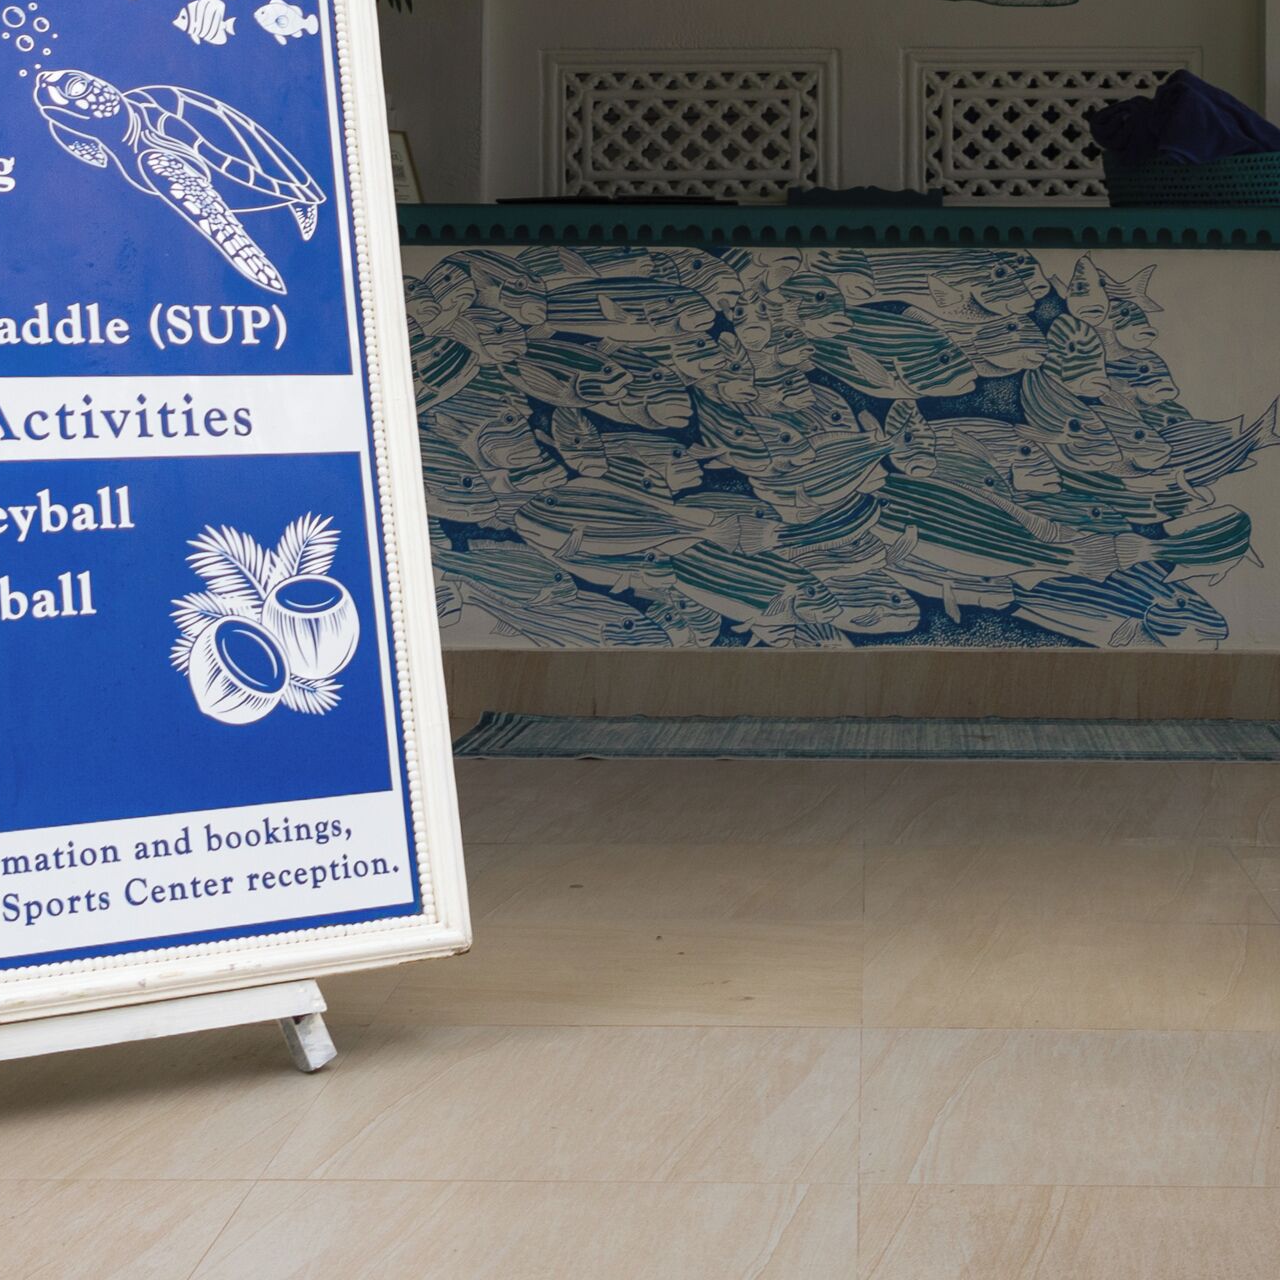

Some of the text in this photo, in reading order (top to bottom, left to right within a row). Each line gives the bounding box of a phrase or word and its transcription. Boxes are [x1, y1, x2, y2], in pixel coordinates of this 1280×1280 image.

[150, 303, 286, 349] (SUP)
[135, 827, 192, 860] and
[204, 818, 351, 851] bookings,
[3, 890, 110, 926] Sports
[125, 877, 233, 906] Center
[247, 858, 400, 892] reception.
